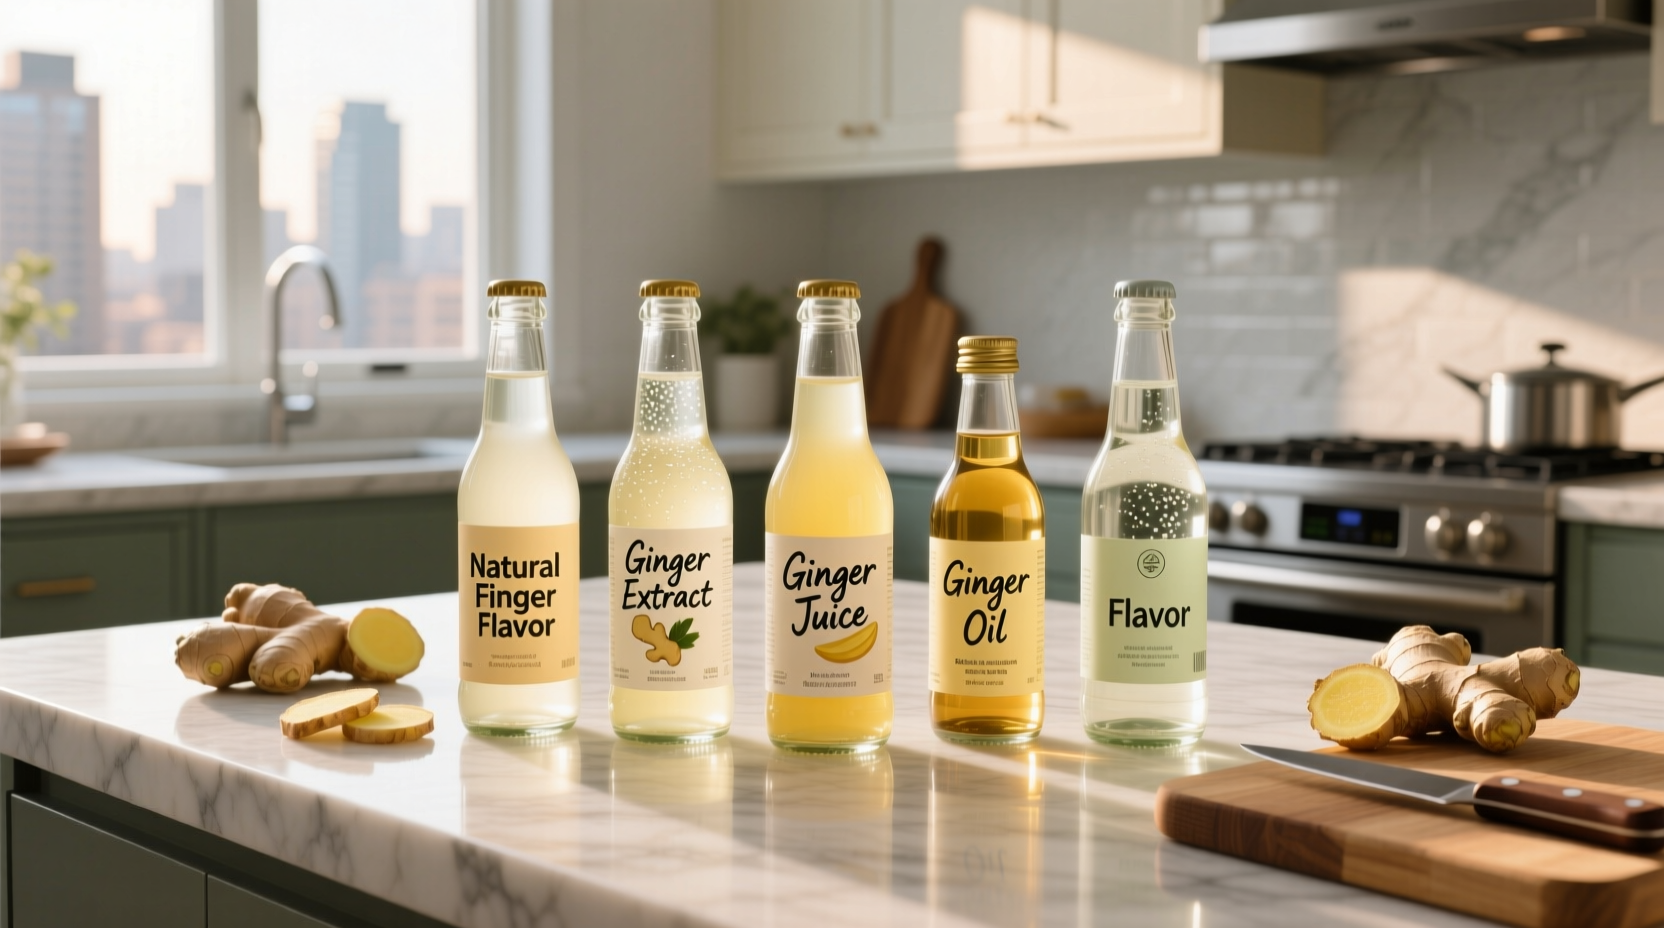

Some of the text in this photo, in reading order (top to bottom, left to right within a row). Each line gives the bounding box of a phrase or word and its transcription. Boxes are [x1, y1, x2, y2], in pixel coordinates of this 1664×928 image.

[470, 552, 560, 579] Natural
[625, 539, 711, 588] Ginger
[782, 550, 877, 604] Ginger
[476, 582, 557, 615] Finger
[621, 578, 714, 610] Extract
[943, 559, 1030, 612] Ginger
[478, 611, 556, 638] Flavor
[791, 594, 868, 637] Juice
[963, 608, 1008, 646] Oil
[1109, 597, 1191, 629] Flavor
